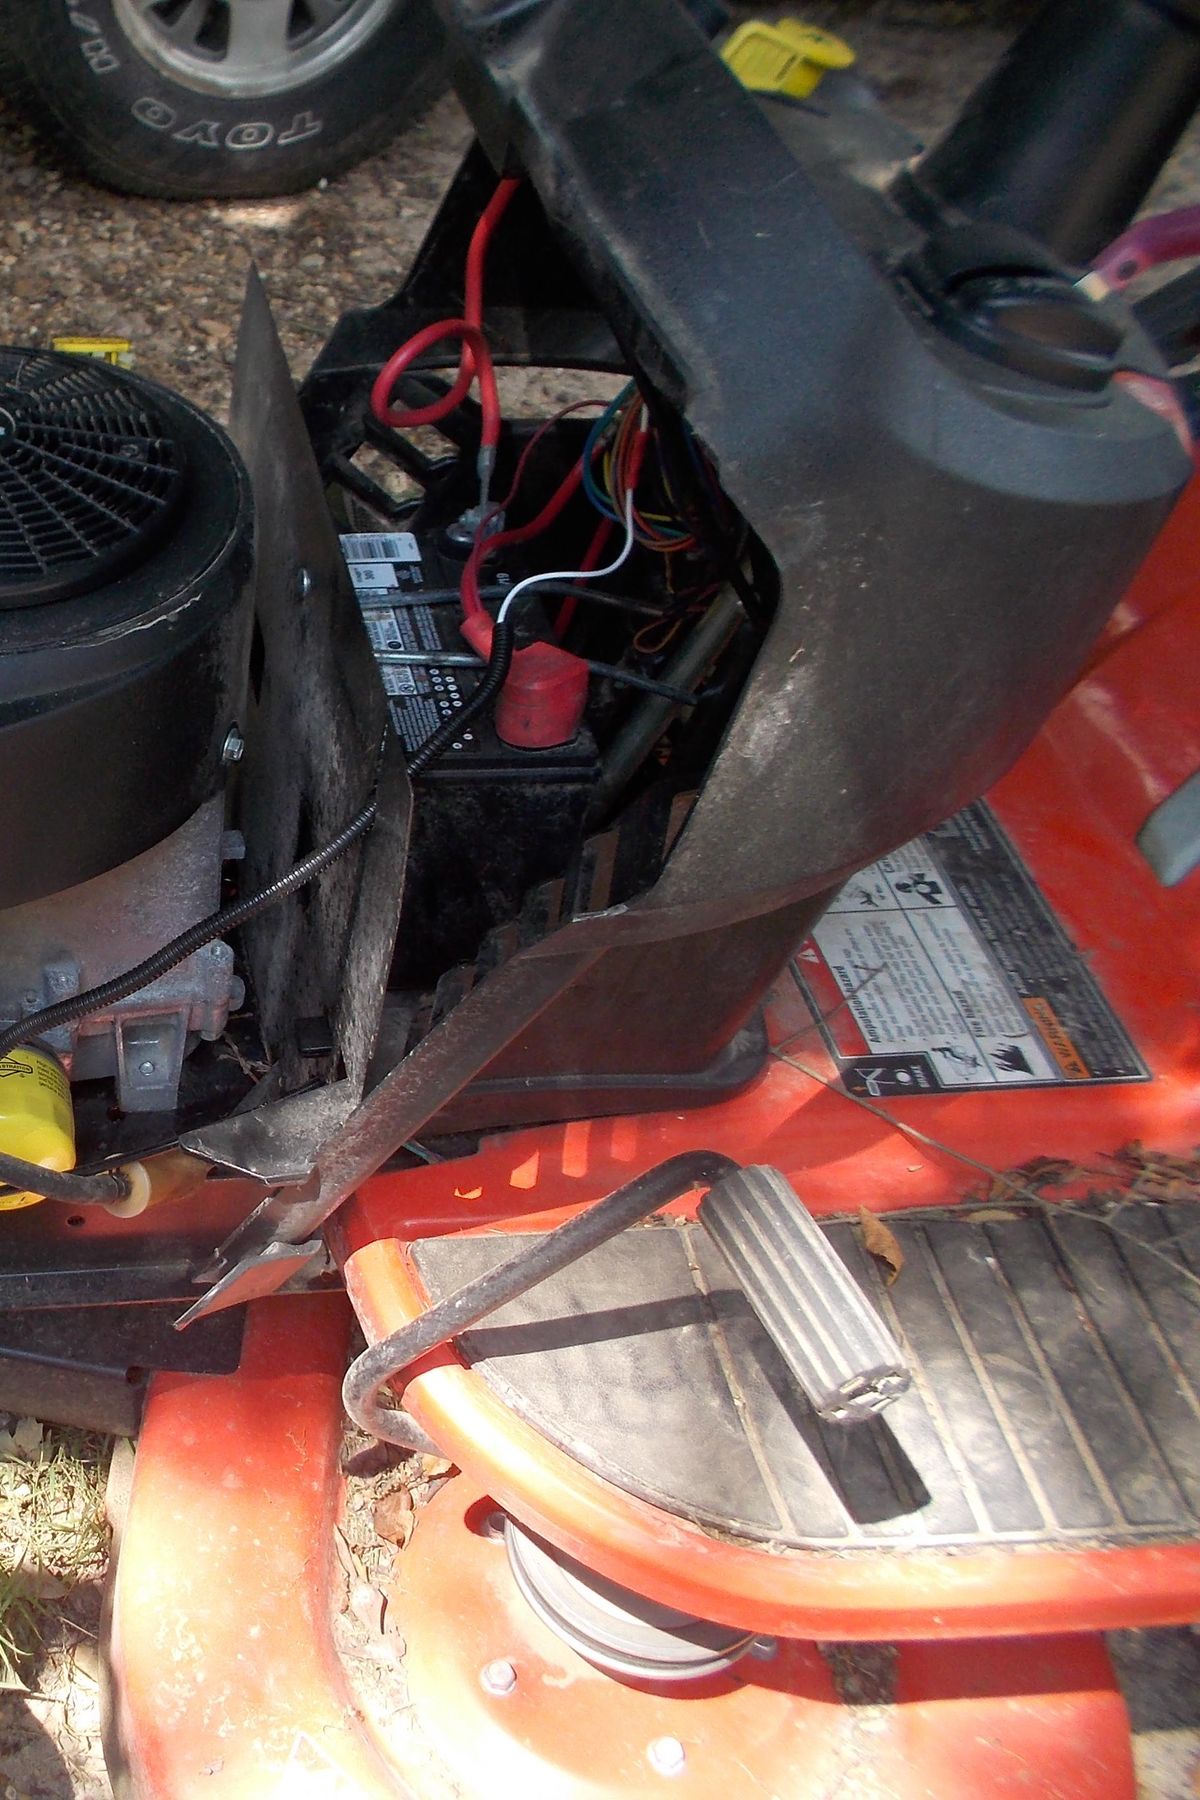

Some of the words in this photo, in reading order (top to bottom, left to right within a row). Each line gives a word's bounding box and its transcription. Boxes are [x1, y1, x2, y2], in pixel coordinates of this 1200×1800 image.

[131, 97, 322, 150] TOYO
[832, 965, 856, 993] hazard
[951, 990, 977, 1019] hazard
[846, 995, 882, 1044] Amputation
[971, 1021, 987, 1038] Fire
